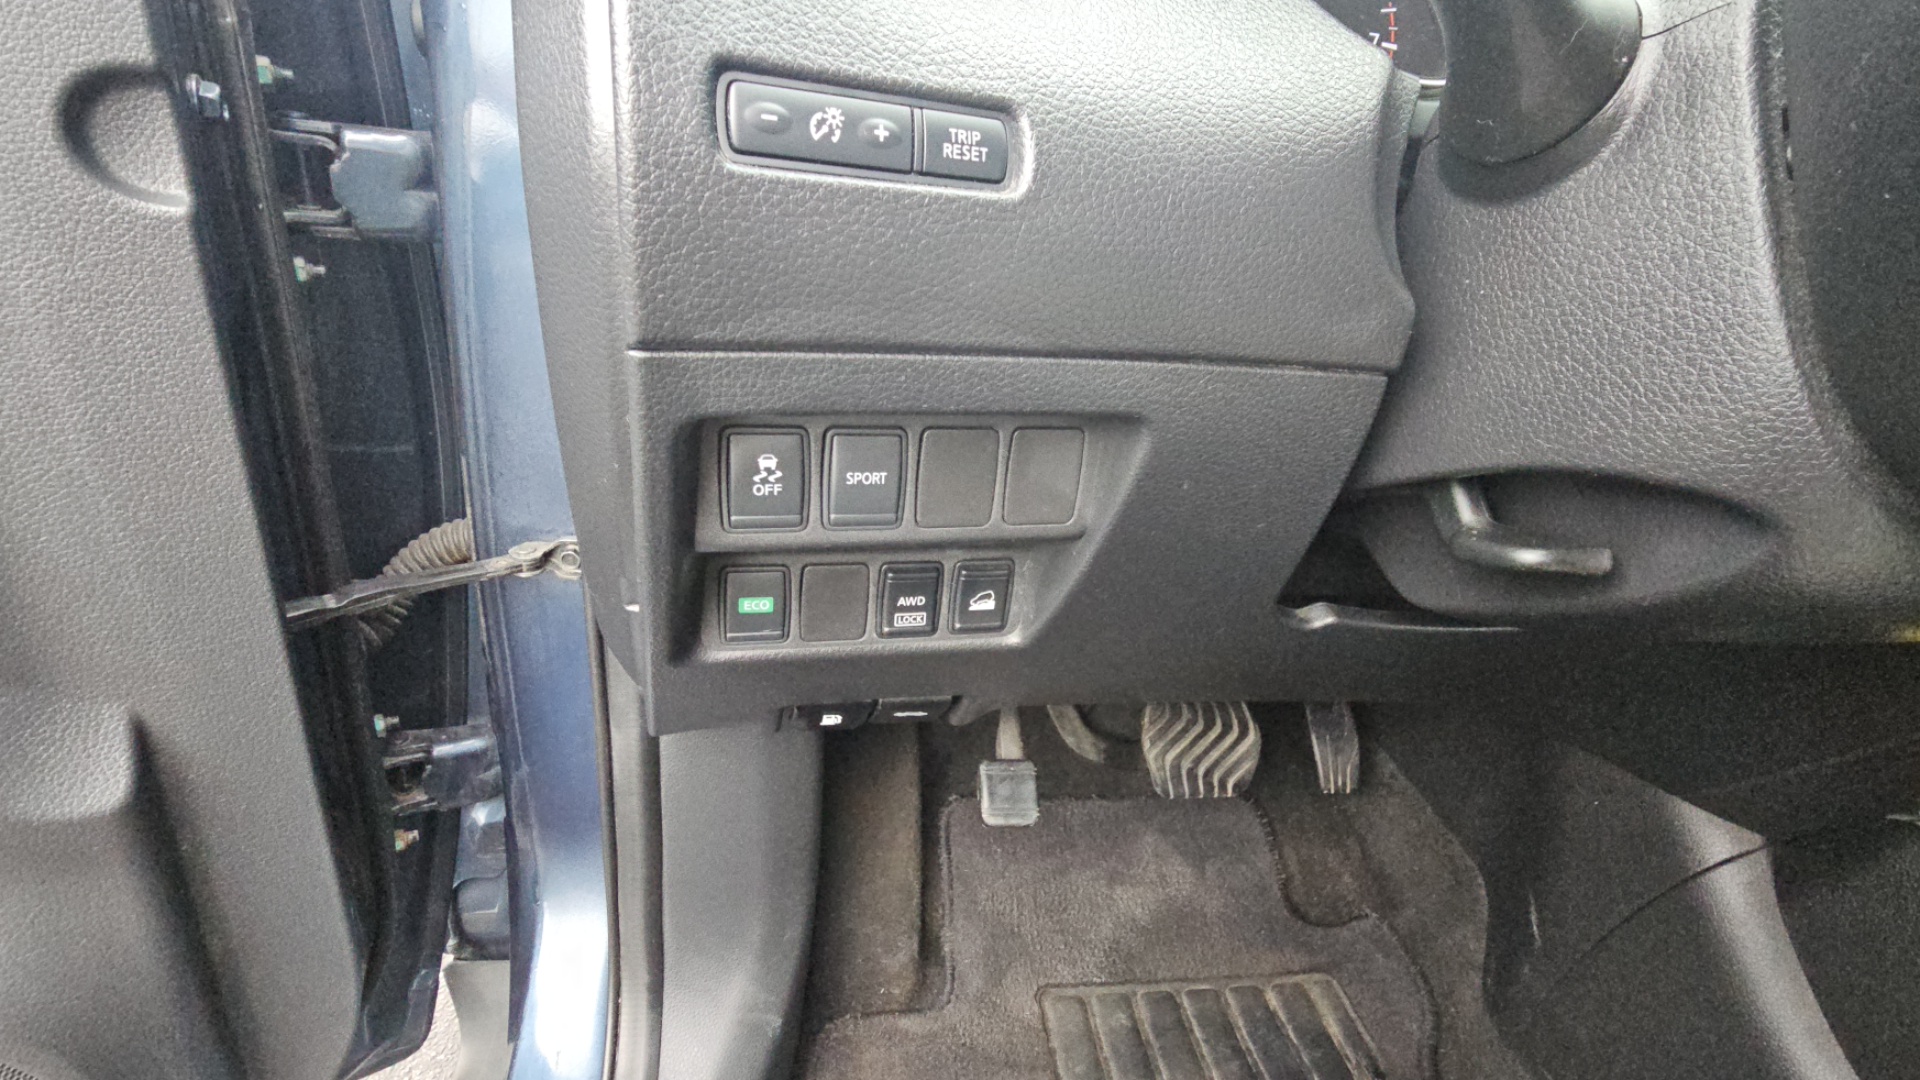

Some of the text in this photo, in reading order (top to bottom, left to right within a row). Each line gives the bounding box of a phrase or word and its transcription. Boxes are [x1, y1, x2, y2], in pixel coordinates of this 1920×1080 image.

[1369, 32, 1380, 45] 7
[948, 128, 981, 145] TRIP
[942, 143, 989, 162] RESET
[846, 472, 888, 485] SPORT
[753, 484, 782, 496] OFF
[743, 600, 770, 611] ECO
[897, 596, 926, 606] AWD
[897, 615, 924, 624] LOCK
